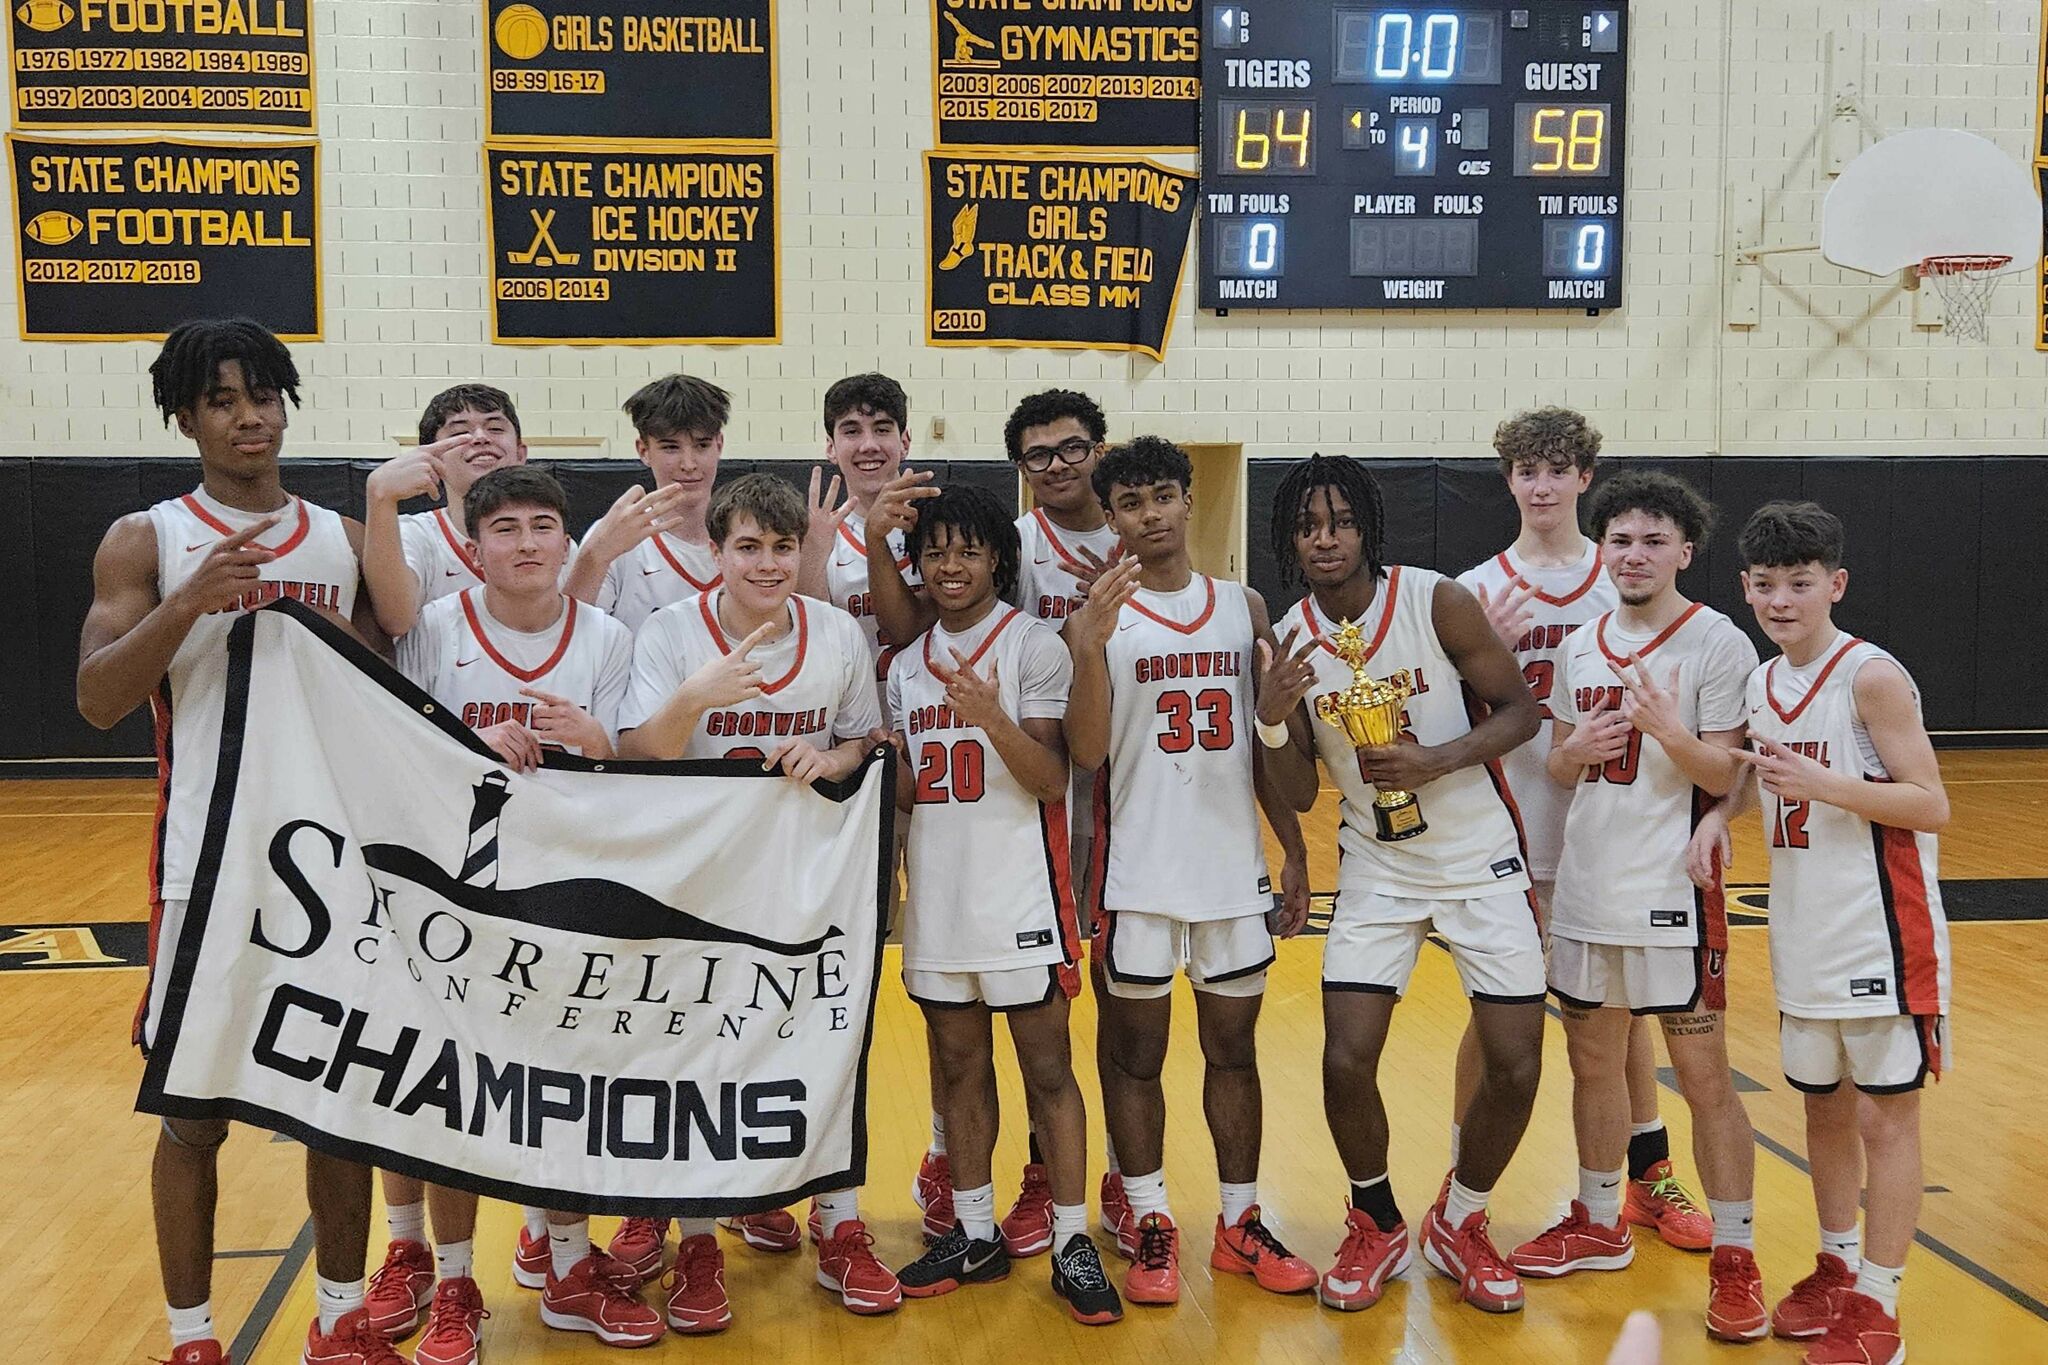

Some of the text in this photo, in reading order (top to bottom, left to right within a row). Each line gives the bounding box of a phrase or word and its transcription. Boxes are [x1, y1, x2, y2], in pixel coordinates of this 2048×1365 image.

[81, 0, 304, 36] FOOTBALL
[553, 15, 764, 53] GIRLS BASKETBALL
[1000, 25, 1199, 62] GYMNASTICS
[1375, 13, 1459, 78] 0.0
[20, 51, 303, 72] 1976 1977 1982 1984 1989
[1224, 58, 1312, 88] TIGERS
[1525, 62, 1602, 91] GUEST
[495, 72, 600, 91] 98-99 16-17
[942, 75, 1196, 98] 2003 2006 2007 2013 2014
[25, 88, 303, 109] 1997 2003 2004 2005 2011
[944, 100, 1093, 120] 2015 2016 2017
[1390, 97, 1442, 114] PERIOD
[1235, 109, 1312, 170] 64
[1370, 129, 1386, 145] TO
[1402, 125, 1429, 169] 4
[1445, 129, 1462, 145] TO
[1532, 109, 1604, 171] 58
[30, 155, 300, 195] STATE CHAMPIONS
[500, 160, 763, 199] STATE CHAMPIONS
[1458, 161, 1491, 176] OES
[946, 164, 1183, 214] STATE CHAMPIONS
[1208, 194, 1290, 215] TM FOULS
[1354, 195, 1484, 215] PLAYER FOULS
[1538, 196, 1618, 215] TM FOULS
[87, 208, 311, 247] FOOTBALL
[592, 206, 759, 242] ICE HOCKEY
[1028, 205, 1108, 242] GIRLS
[593, 249, 737, 273] DIVISION II
[1247, 222, 1277, 271] 0
[1576, 223, 1606, 271] 0
[29, 263, 196, 282] 2012 2017 2018
[979, 243, 1153, 283] TRACK & FIELD
[502, 281, 605, 299] 2006 2014
[988, 283, 1140, 308] CLASS MM
[1219, 280, 1278, 299] MATCH
[1382, 280, 1445, 299] WEIGHT
[1548, 280, 1606, 299] MATCH
[937, 313, 982, 331] 2010
[1135, 651, 1240, 683] CROMWELL
[706, 707, 827, 737] CROMWELL
[1156, 688, 1234, 753] 33
[914, 739, 985, 804] 20
[249, 819, 849, 1012] SHORELINE
[354, 937, 849, 1040] CONFERENCE
[252, 983, 807, 1161] CHAMPIONS
